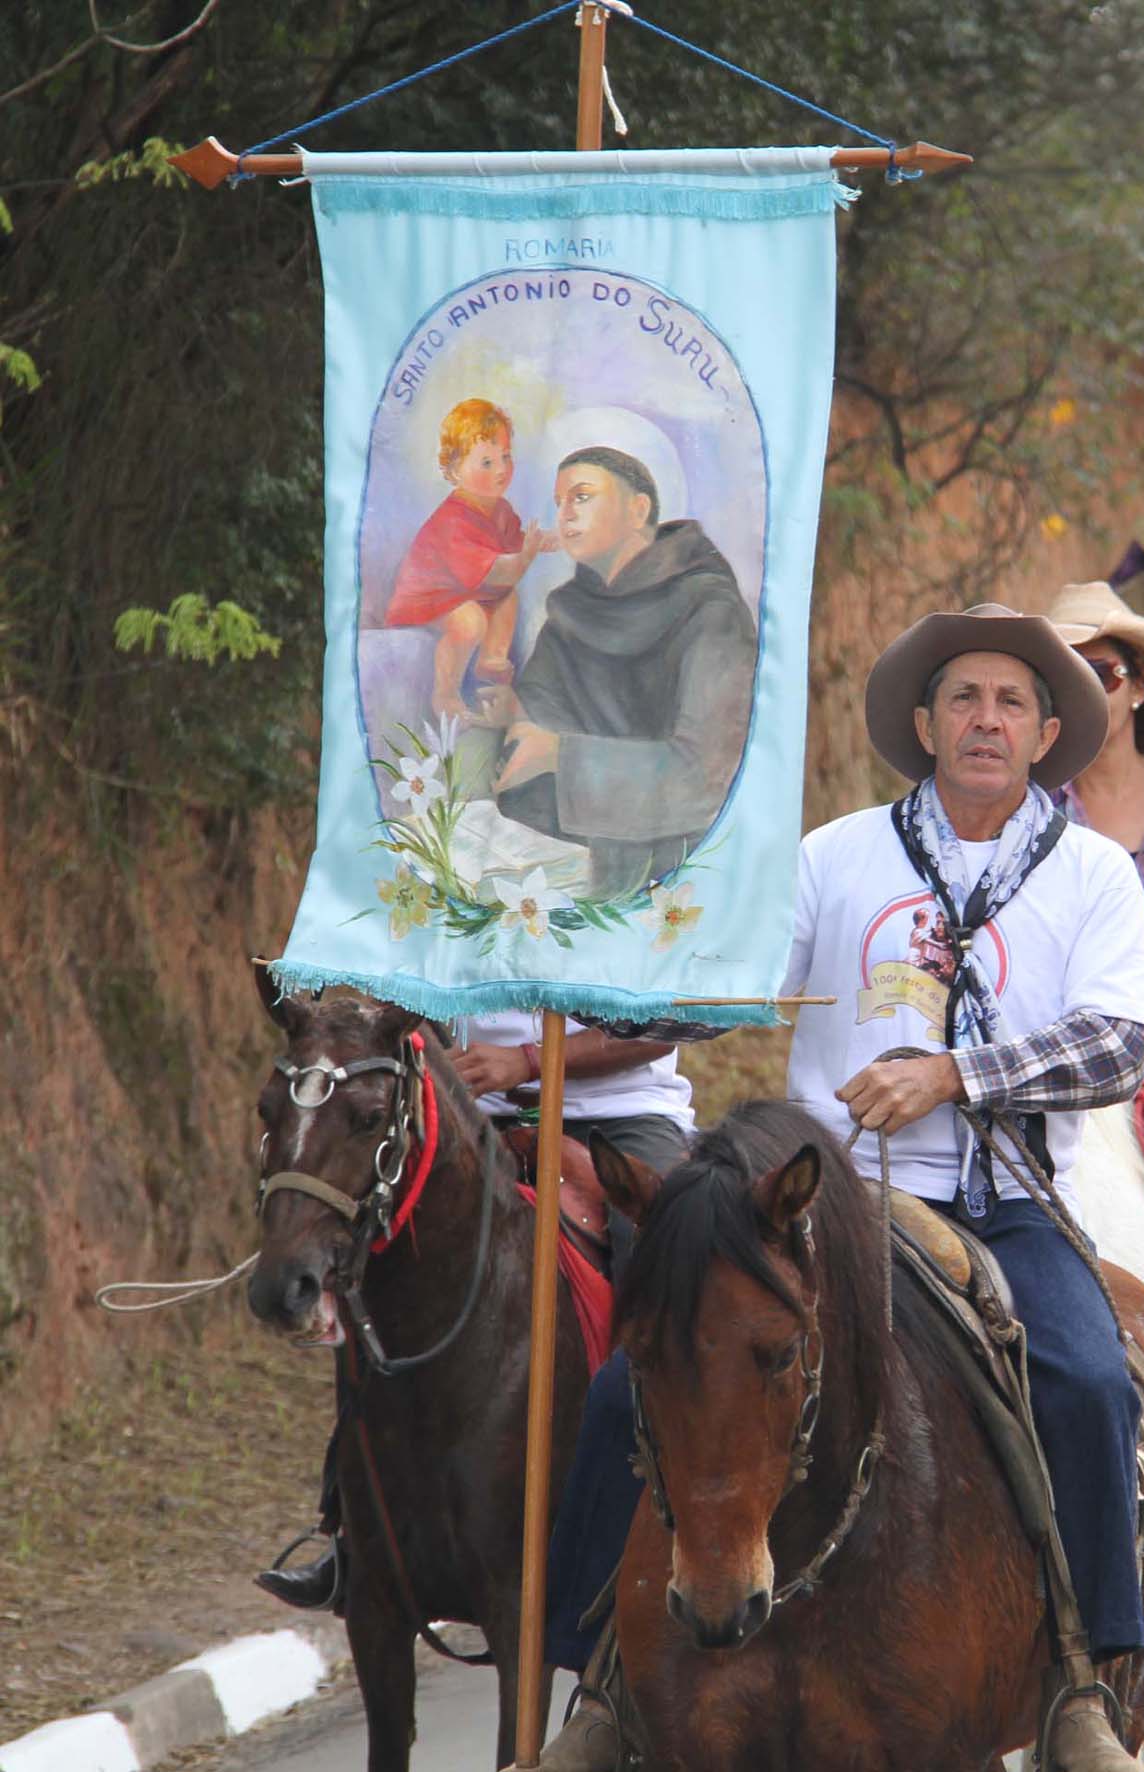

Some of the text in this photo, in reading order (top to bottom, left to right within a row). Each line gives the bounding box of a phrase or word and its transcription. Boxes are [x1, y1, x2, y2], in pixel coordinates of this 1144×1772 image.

[393, 328, 444, 407] SANTO
[449, 274, 571, 328] ANTONIO
[592, 282, 632, 307] DO
